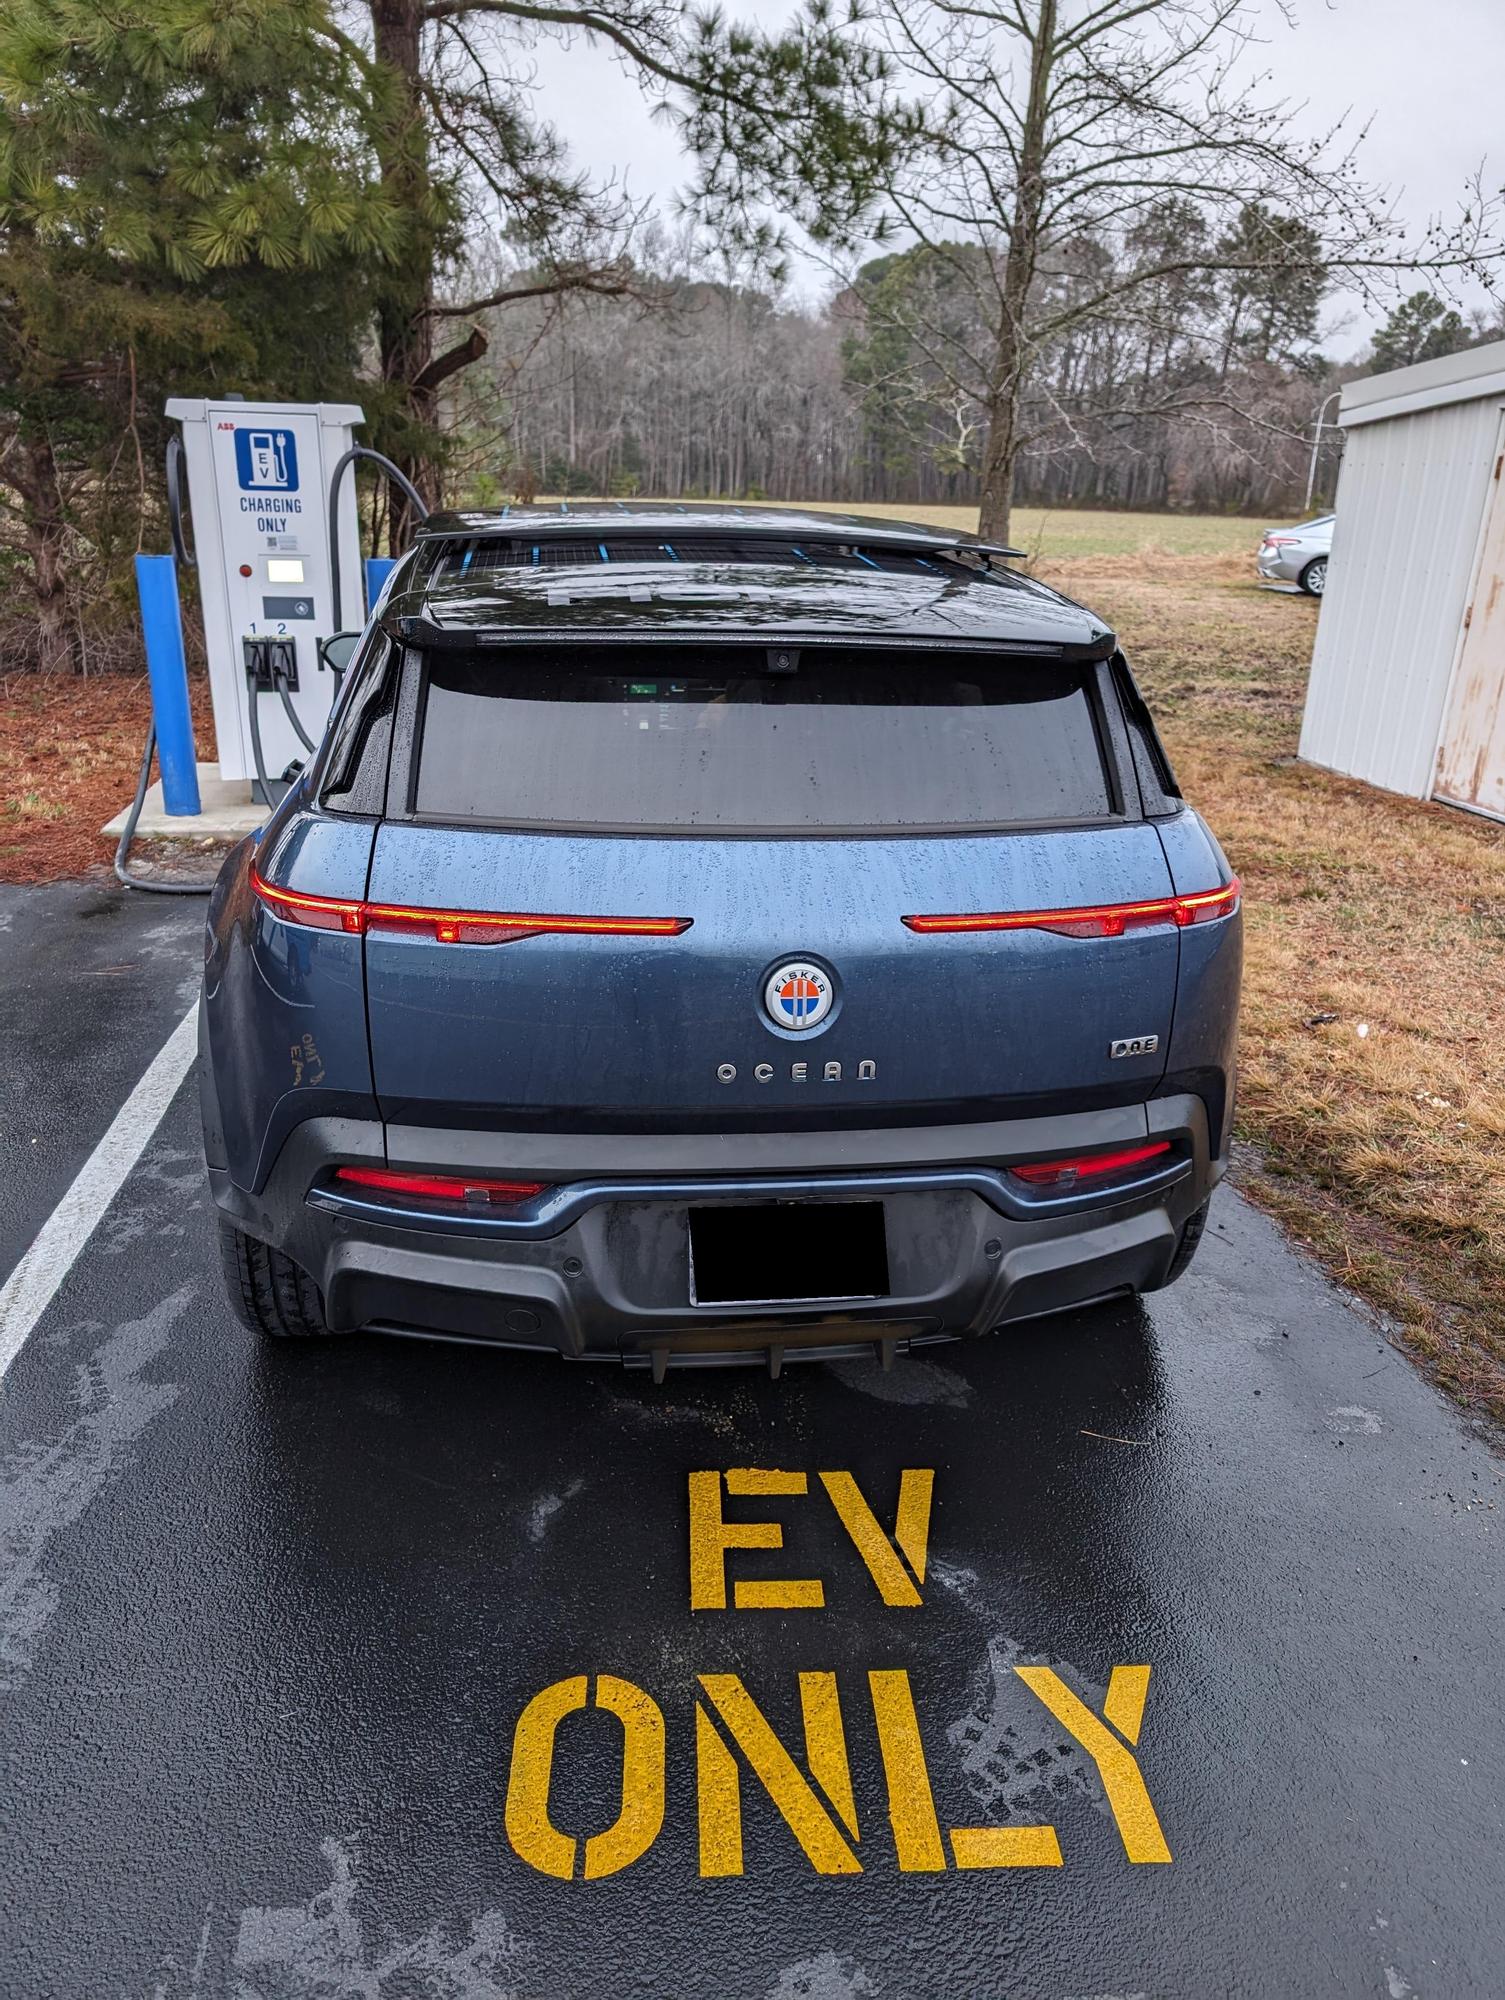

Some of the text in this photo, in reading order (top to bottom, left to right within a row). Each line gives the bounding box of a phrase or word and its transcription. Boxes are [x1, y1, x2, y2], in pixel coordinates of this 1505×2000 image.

[217, 422, 235, 431] ABB
[240, 497, 302, 513] CHARGING
[257, 517, 287, 532] ONLY
[249, 622, 287, 635] 1 2
[774, 971, 826, 994] FISKER
[717, 1060, 877, 1083] OCEAN
[689, 1468, 934, 1609] EV
[504, 1664, 1171, 1880] ONLY
